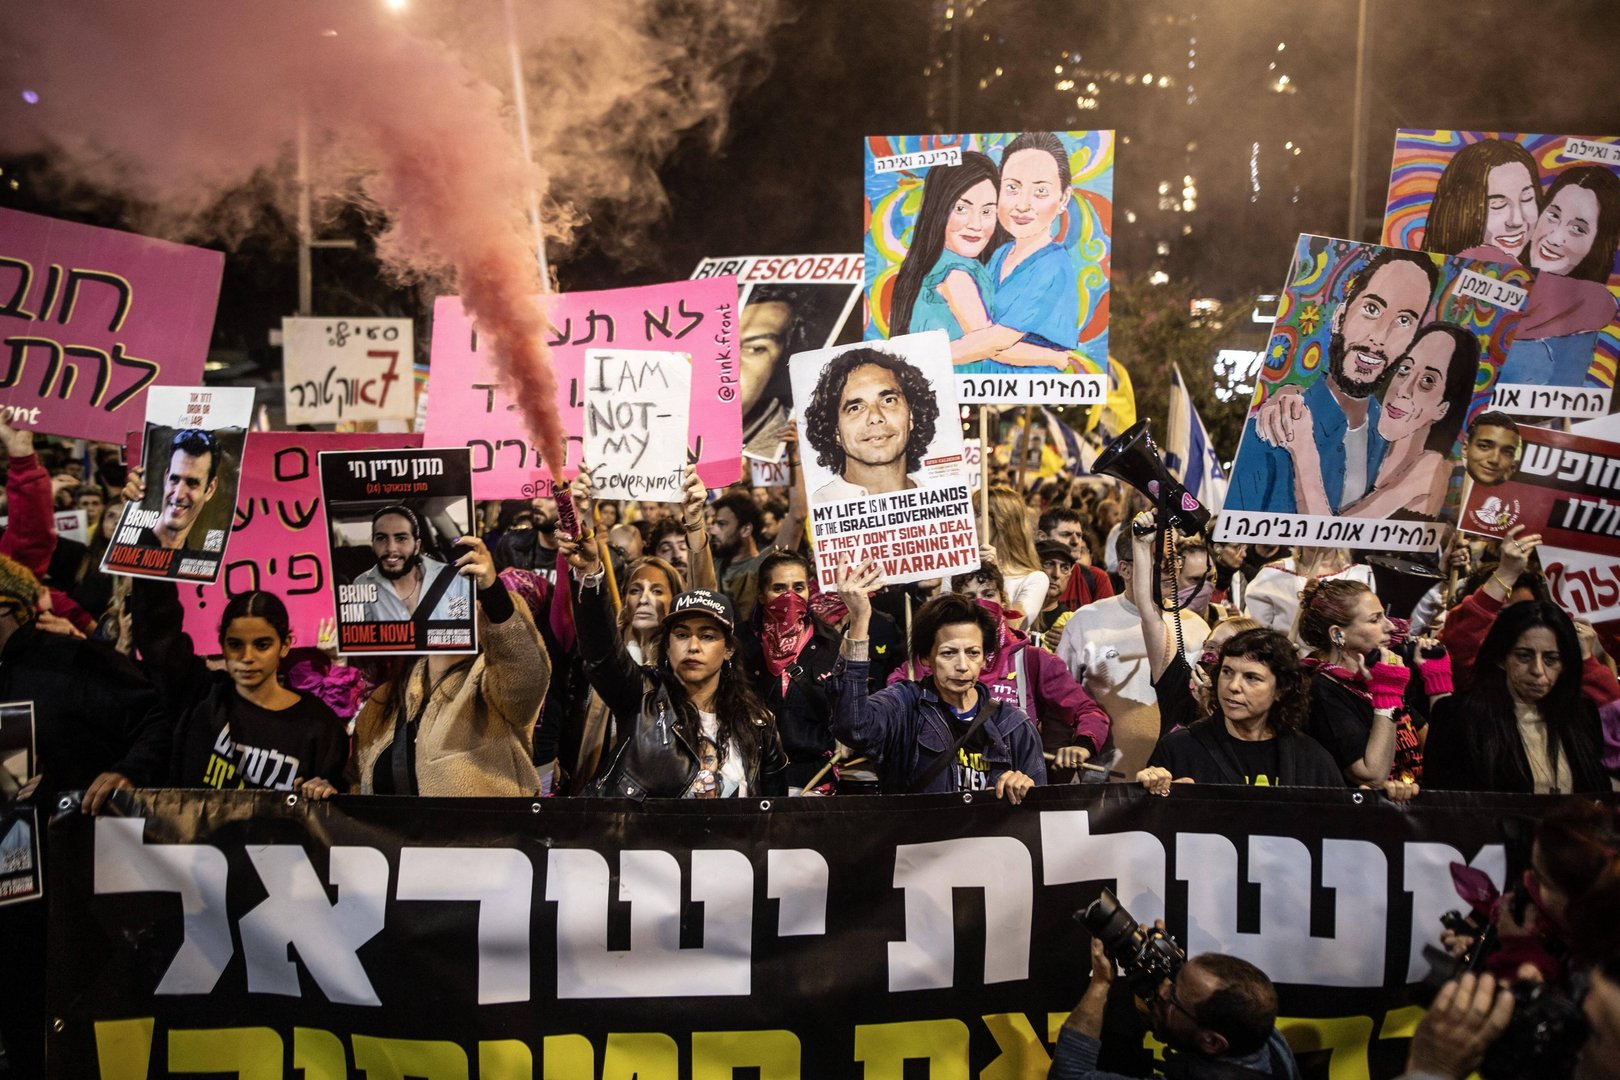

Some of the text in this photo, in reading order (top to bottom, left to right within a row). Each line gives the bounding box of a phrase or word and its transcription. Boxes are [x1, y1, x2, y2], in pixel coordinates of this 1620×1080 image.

[877, 149, 959, 170] קרינה ואירה
[700, 257, 865, 281] BIBI ESCOBAR
[1458, 275, 1524, 306] עינב ומתן
[643, 299, 704, 341] לא
[715, 303, 738, 402] @pink.front
[589, 356, 669, 392] I AM
[962, 378, 1100, 398] החזירו אותה
[1530, 390, 1604, 412] החזירו
[603, 431, 650, 469] MY
[347, 460, 367, 478] חי
[368, 458, 408, 481] עדיין
[411, 457, 444, 480] מתן
[813, 486, 968, 522] MY LIFE IS IN THE HANDS
[124, 509, 160, 529] BRING
[815, 502, 969, 536] OF THE ISRAELI GOVERNMENT
[116, 526, 143, 545] HIM
[817, 518, 973, 552] IF THEY DON'T SIGN A DEAL
[1315, 521, 1365, 542] אותו
[1370, 524, 1437, 546] החזירו
[109, 545, 175, 569] HOME NOW!
[819, 532, 974, 568] THY ARE SIGNING MY
[882, 547, 977, 577] WARRANT!
[339, 583, 379, 603] BRING
[340, 603, 365, 622] HIM
[342, 621, 416, 643] HOME NOW!
[94, 816, 830, 1006] ישראל
